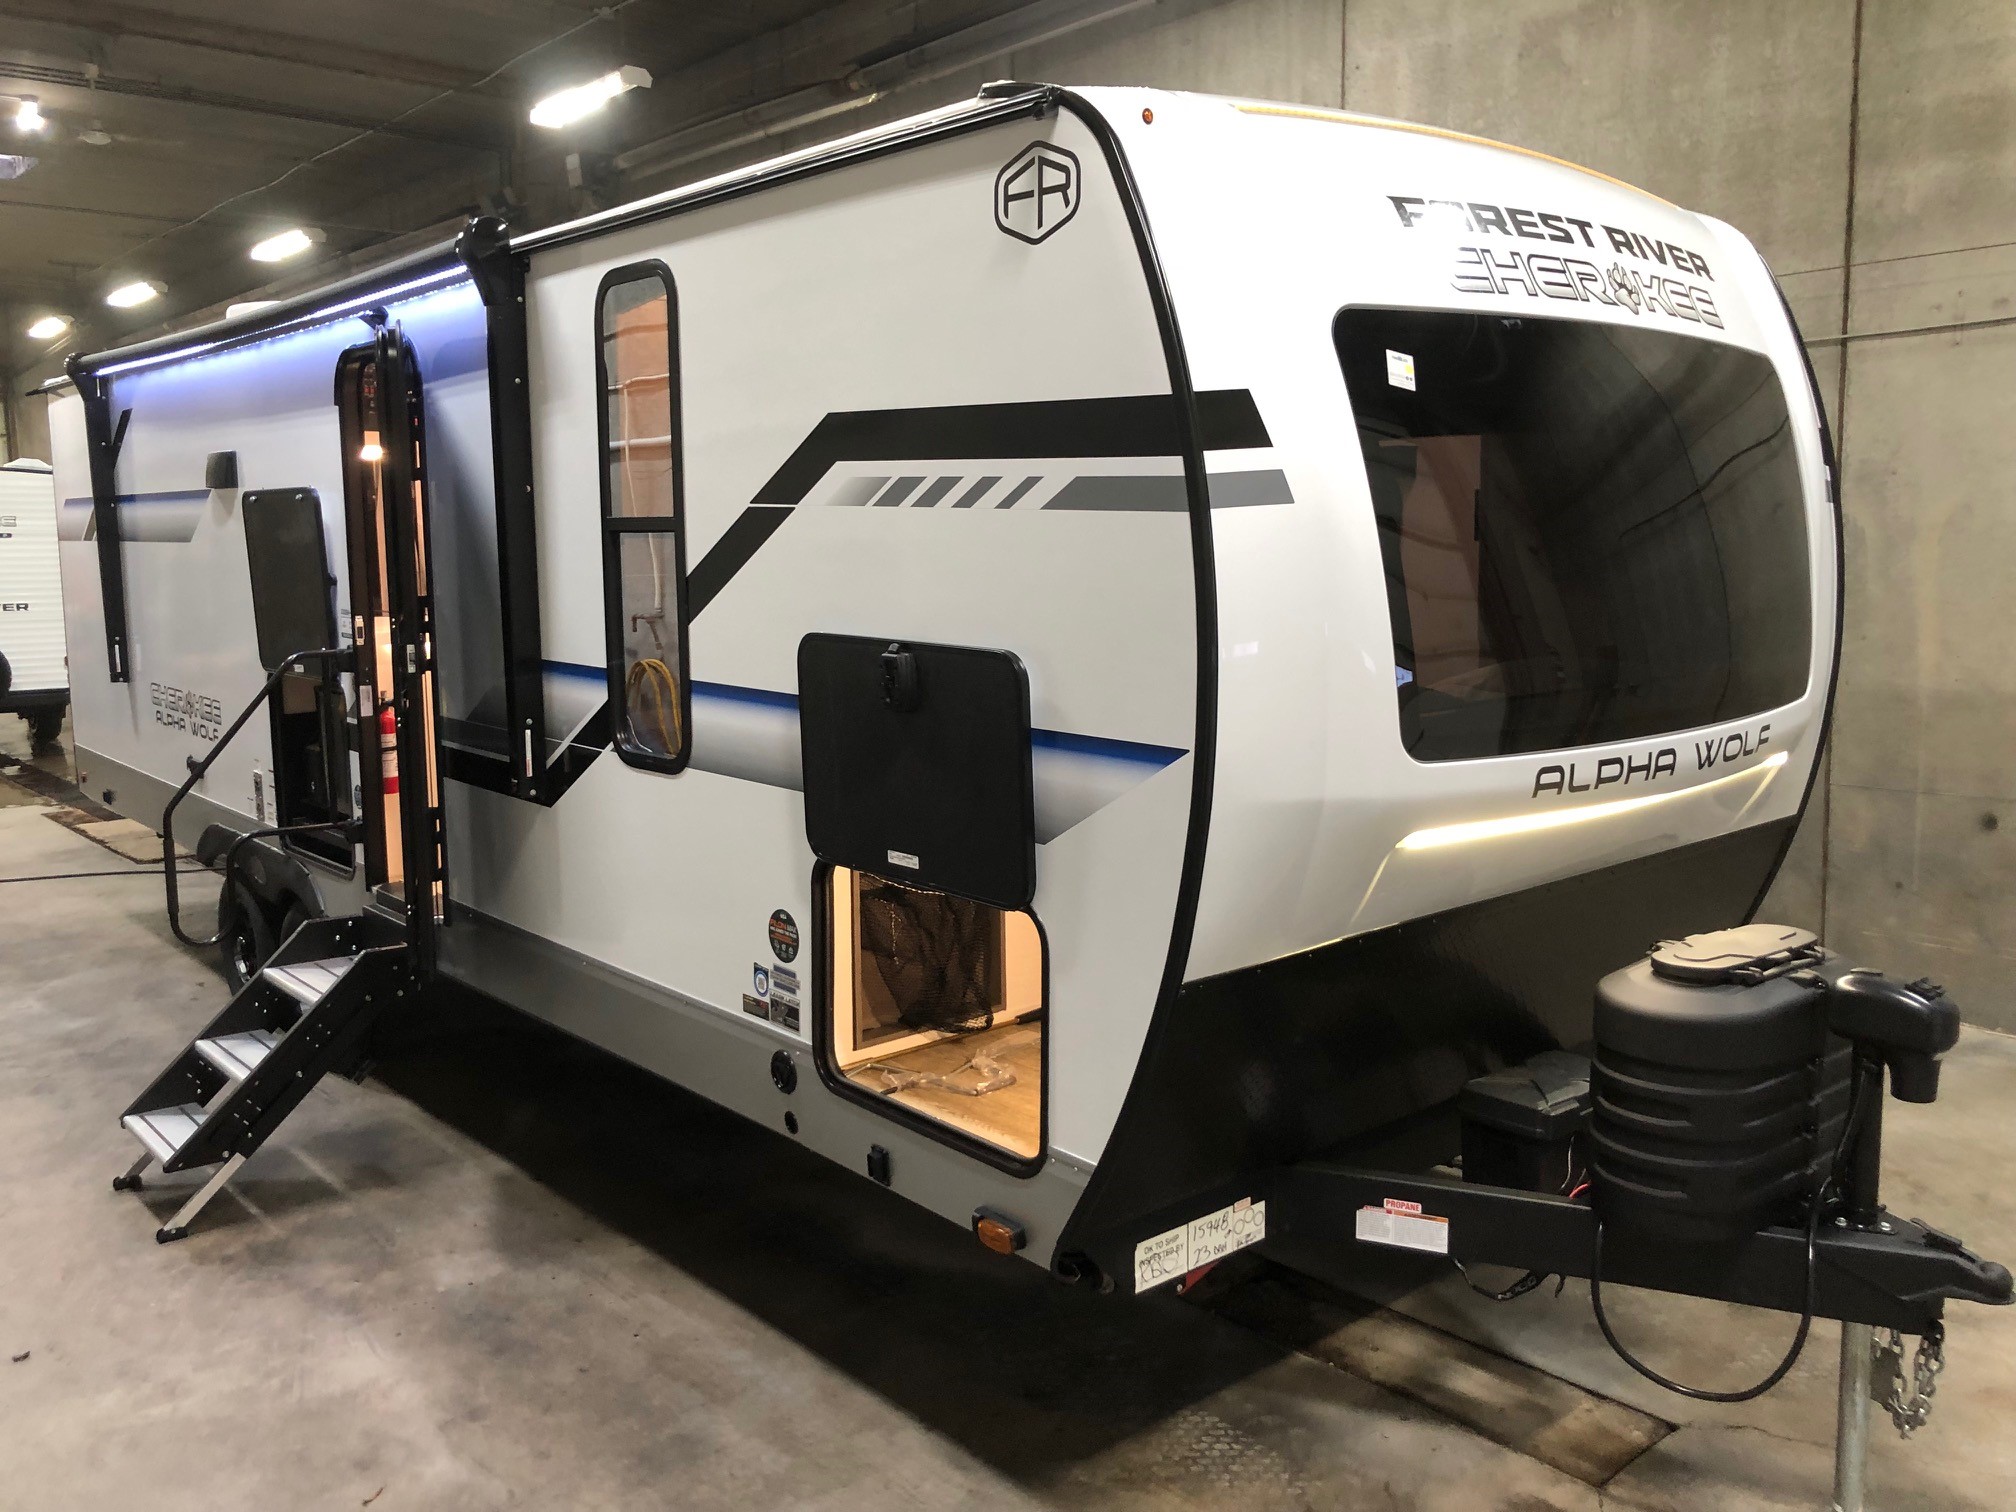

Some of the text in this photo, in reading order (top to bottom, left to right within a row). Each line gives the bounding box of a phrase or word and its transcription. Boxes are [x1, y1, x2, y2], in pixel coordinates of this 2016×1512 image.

[1600, 224, 1715, 282] RIVER
[156, 710, 219, 742] ALPHA WOLF
[1531, 723, 1771, 798] ALPHA WOLF
[1386, 1200, 1420, 1212] PROPANE
[1155, 1241, 1164, 1250] TO
